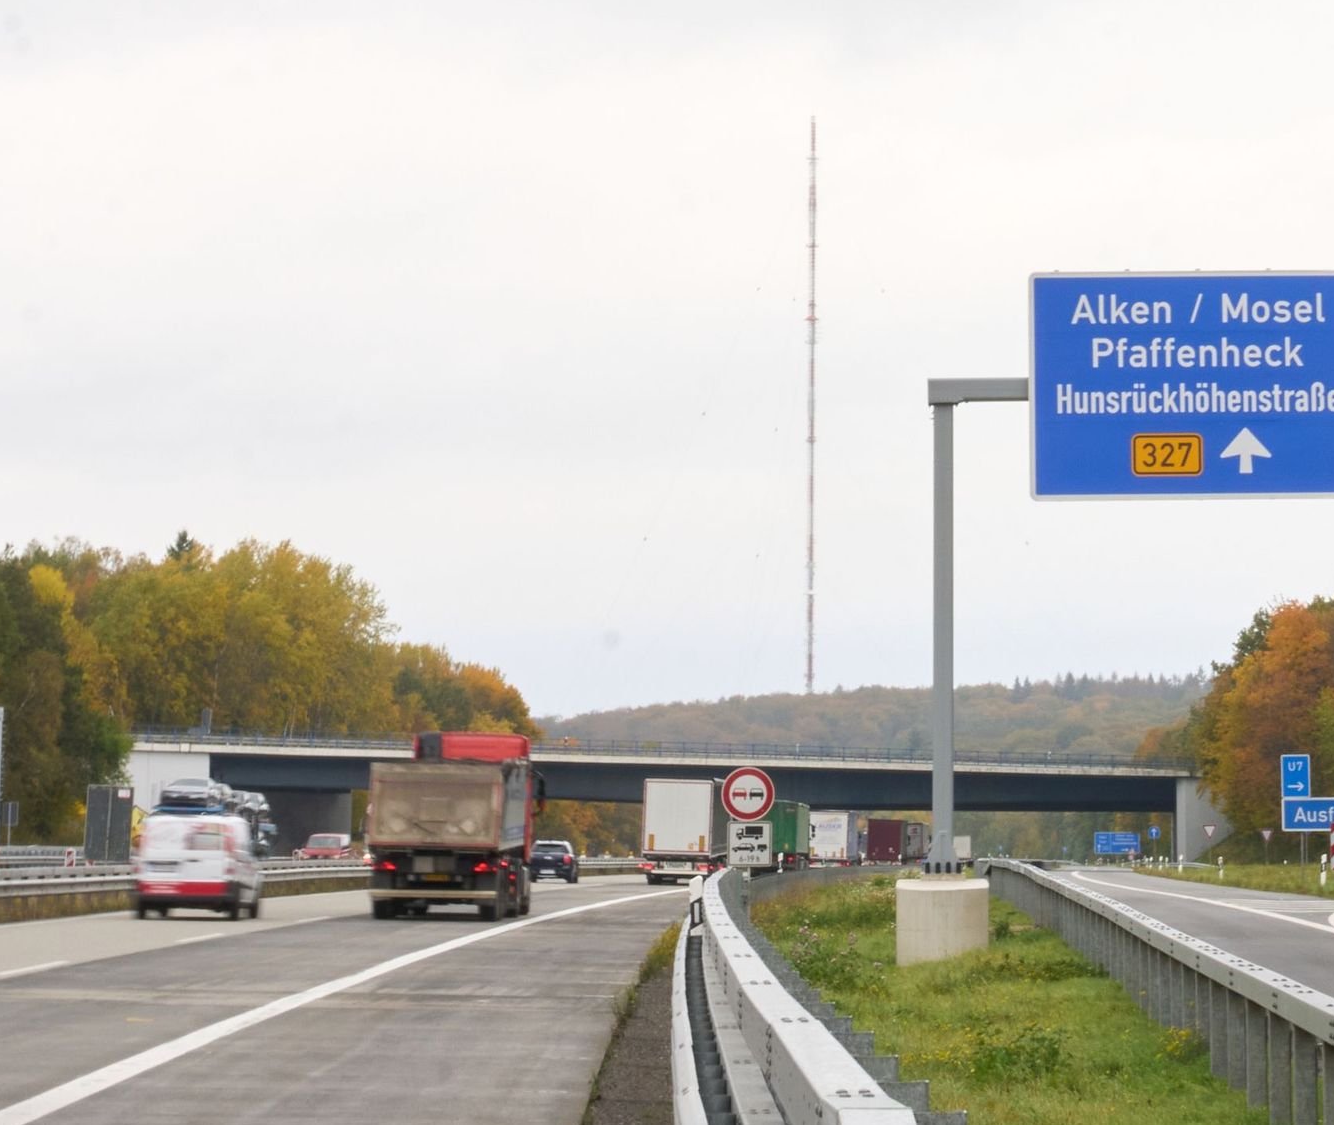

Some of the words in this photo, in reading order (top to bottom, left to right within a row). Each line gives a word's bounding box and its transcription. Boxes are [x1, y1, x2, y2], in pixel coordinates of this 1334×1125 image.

[1071, 293, 1172, 325] Alken
[1190, 293, 1203, 325] /
[1221, 292, 1326, 324] Mosel
[1092, 336, 1304, 368] Pfaffenheck
[1141, 442, 1194, 468] 327
[1287, 761, 1304, 771] U7
